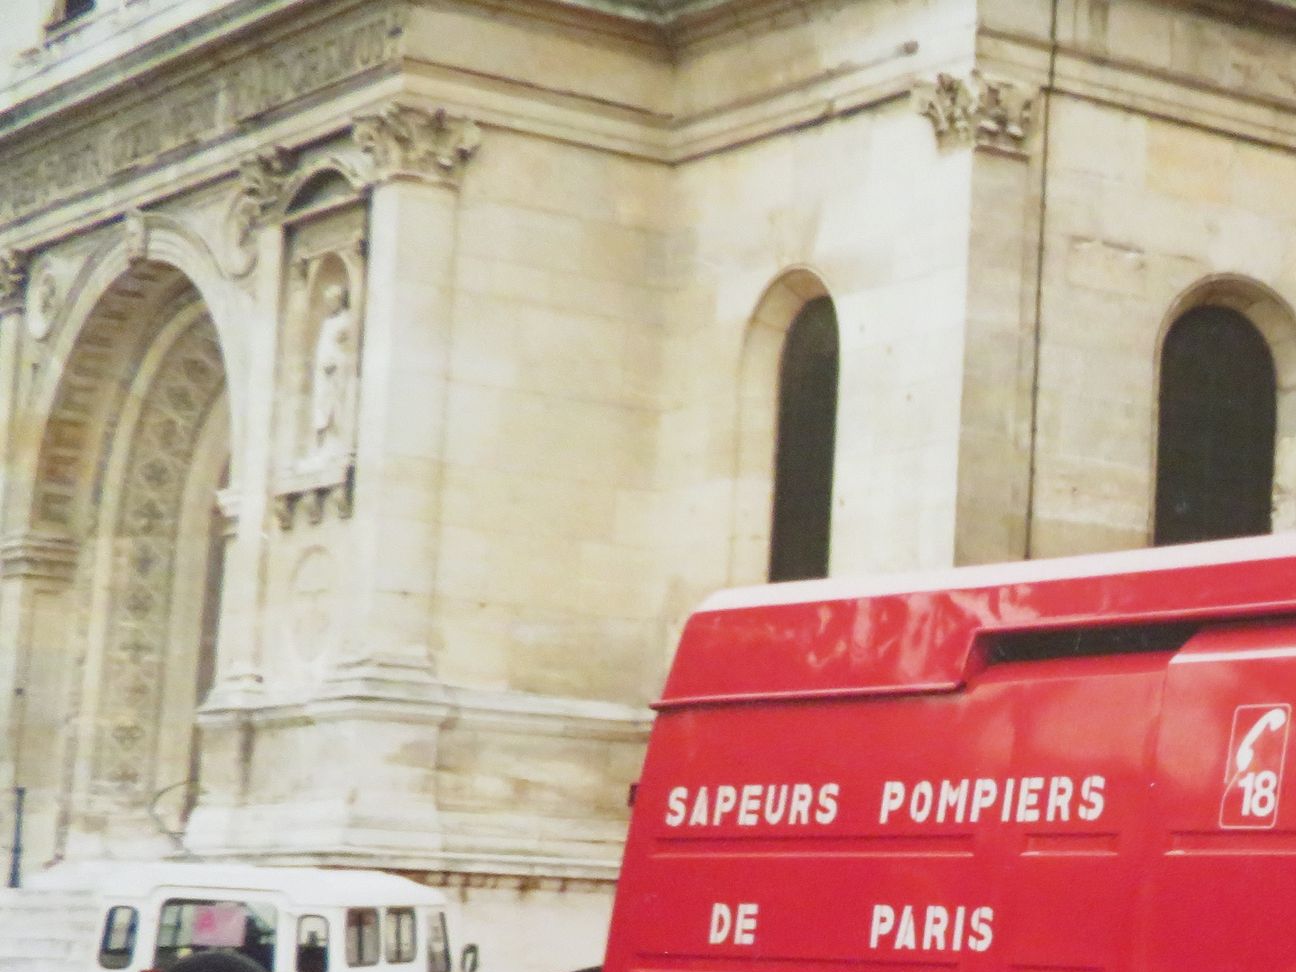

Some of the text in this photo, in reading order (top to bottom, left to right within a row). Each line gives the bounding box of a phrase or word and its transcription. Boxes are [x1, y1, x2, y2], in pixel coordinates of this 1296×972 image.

[665, 775, 1106, 828] SAPEURS POMPIERS
[1237, 770, 1277, 817] 18
[708, 903, 994, 952] DE PARIS
